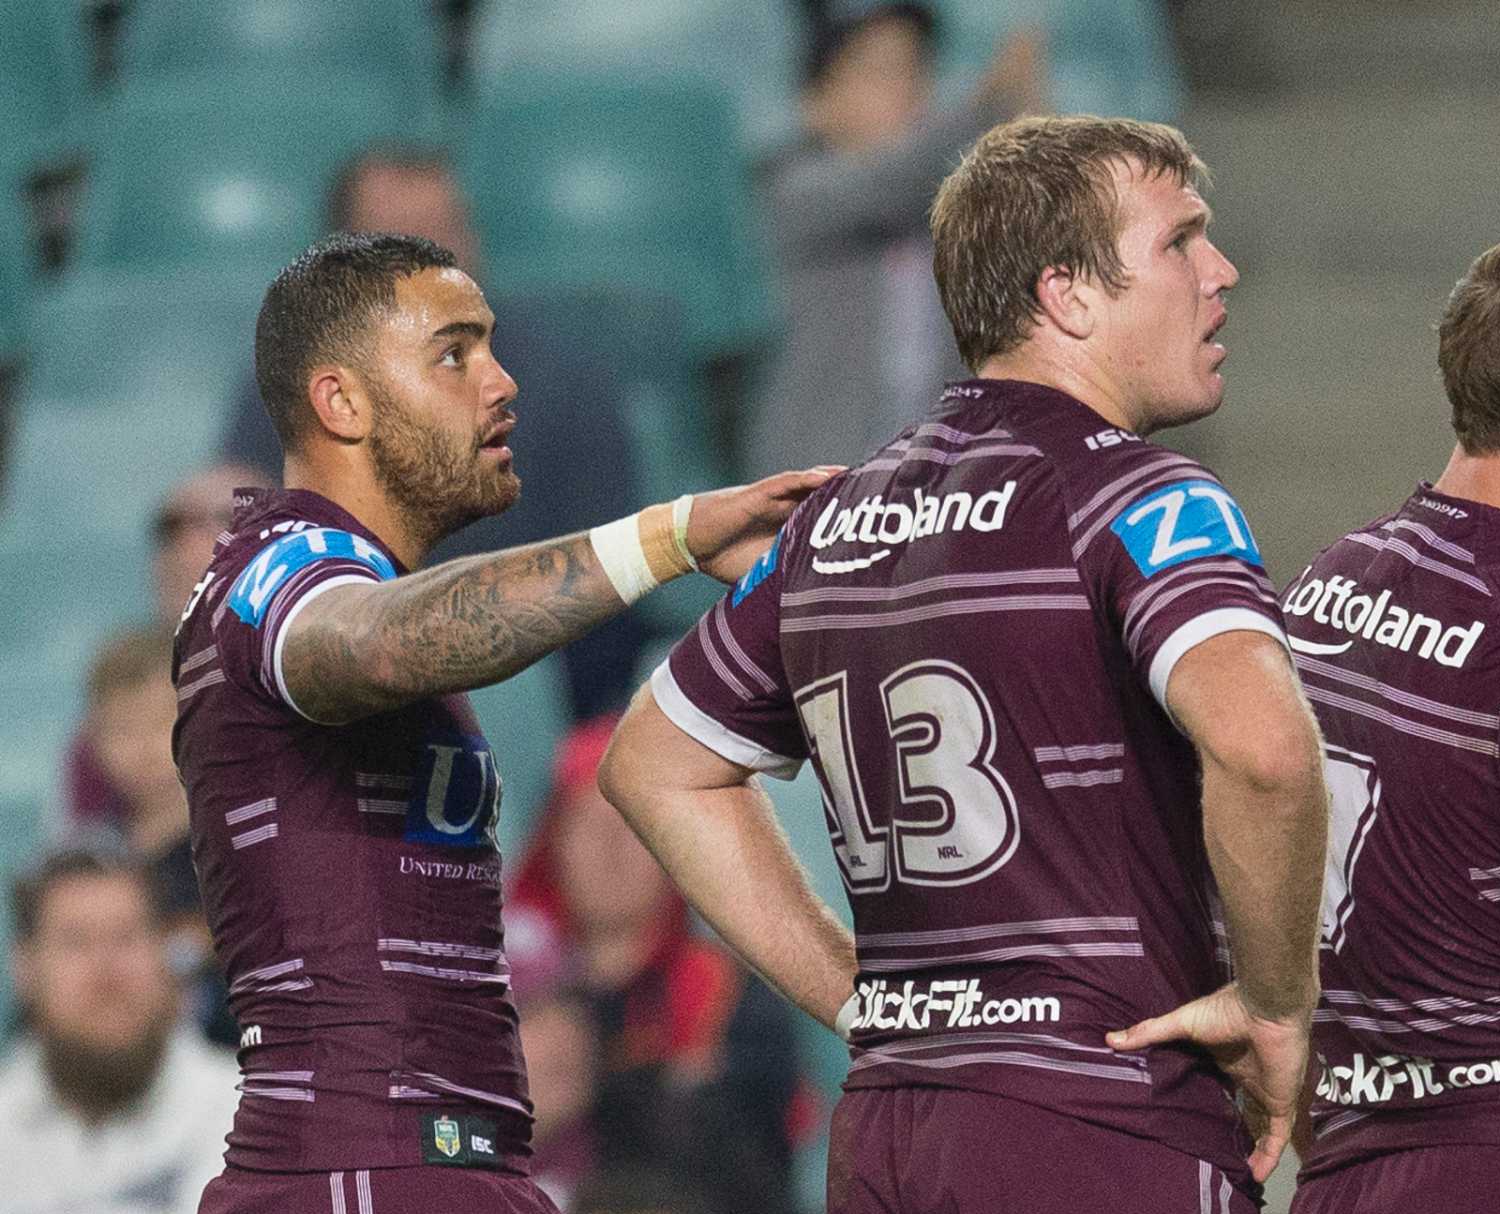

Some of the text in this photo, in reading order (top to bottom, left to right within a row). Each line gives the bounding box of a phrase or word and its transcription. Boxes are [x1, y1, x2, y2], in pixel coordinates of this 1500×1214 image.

[1126, 488, 1260, 566] ZT
[793, 658, 1021, 895] 13
[937, 846, 963, 860] NRL
[471, 1134, 494, 1155] ISC
